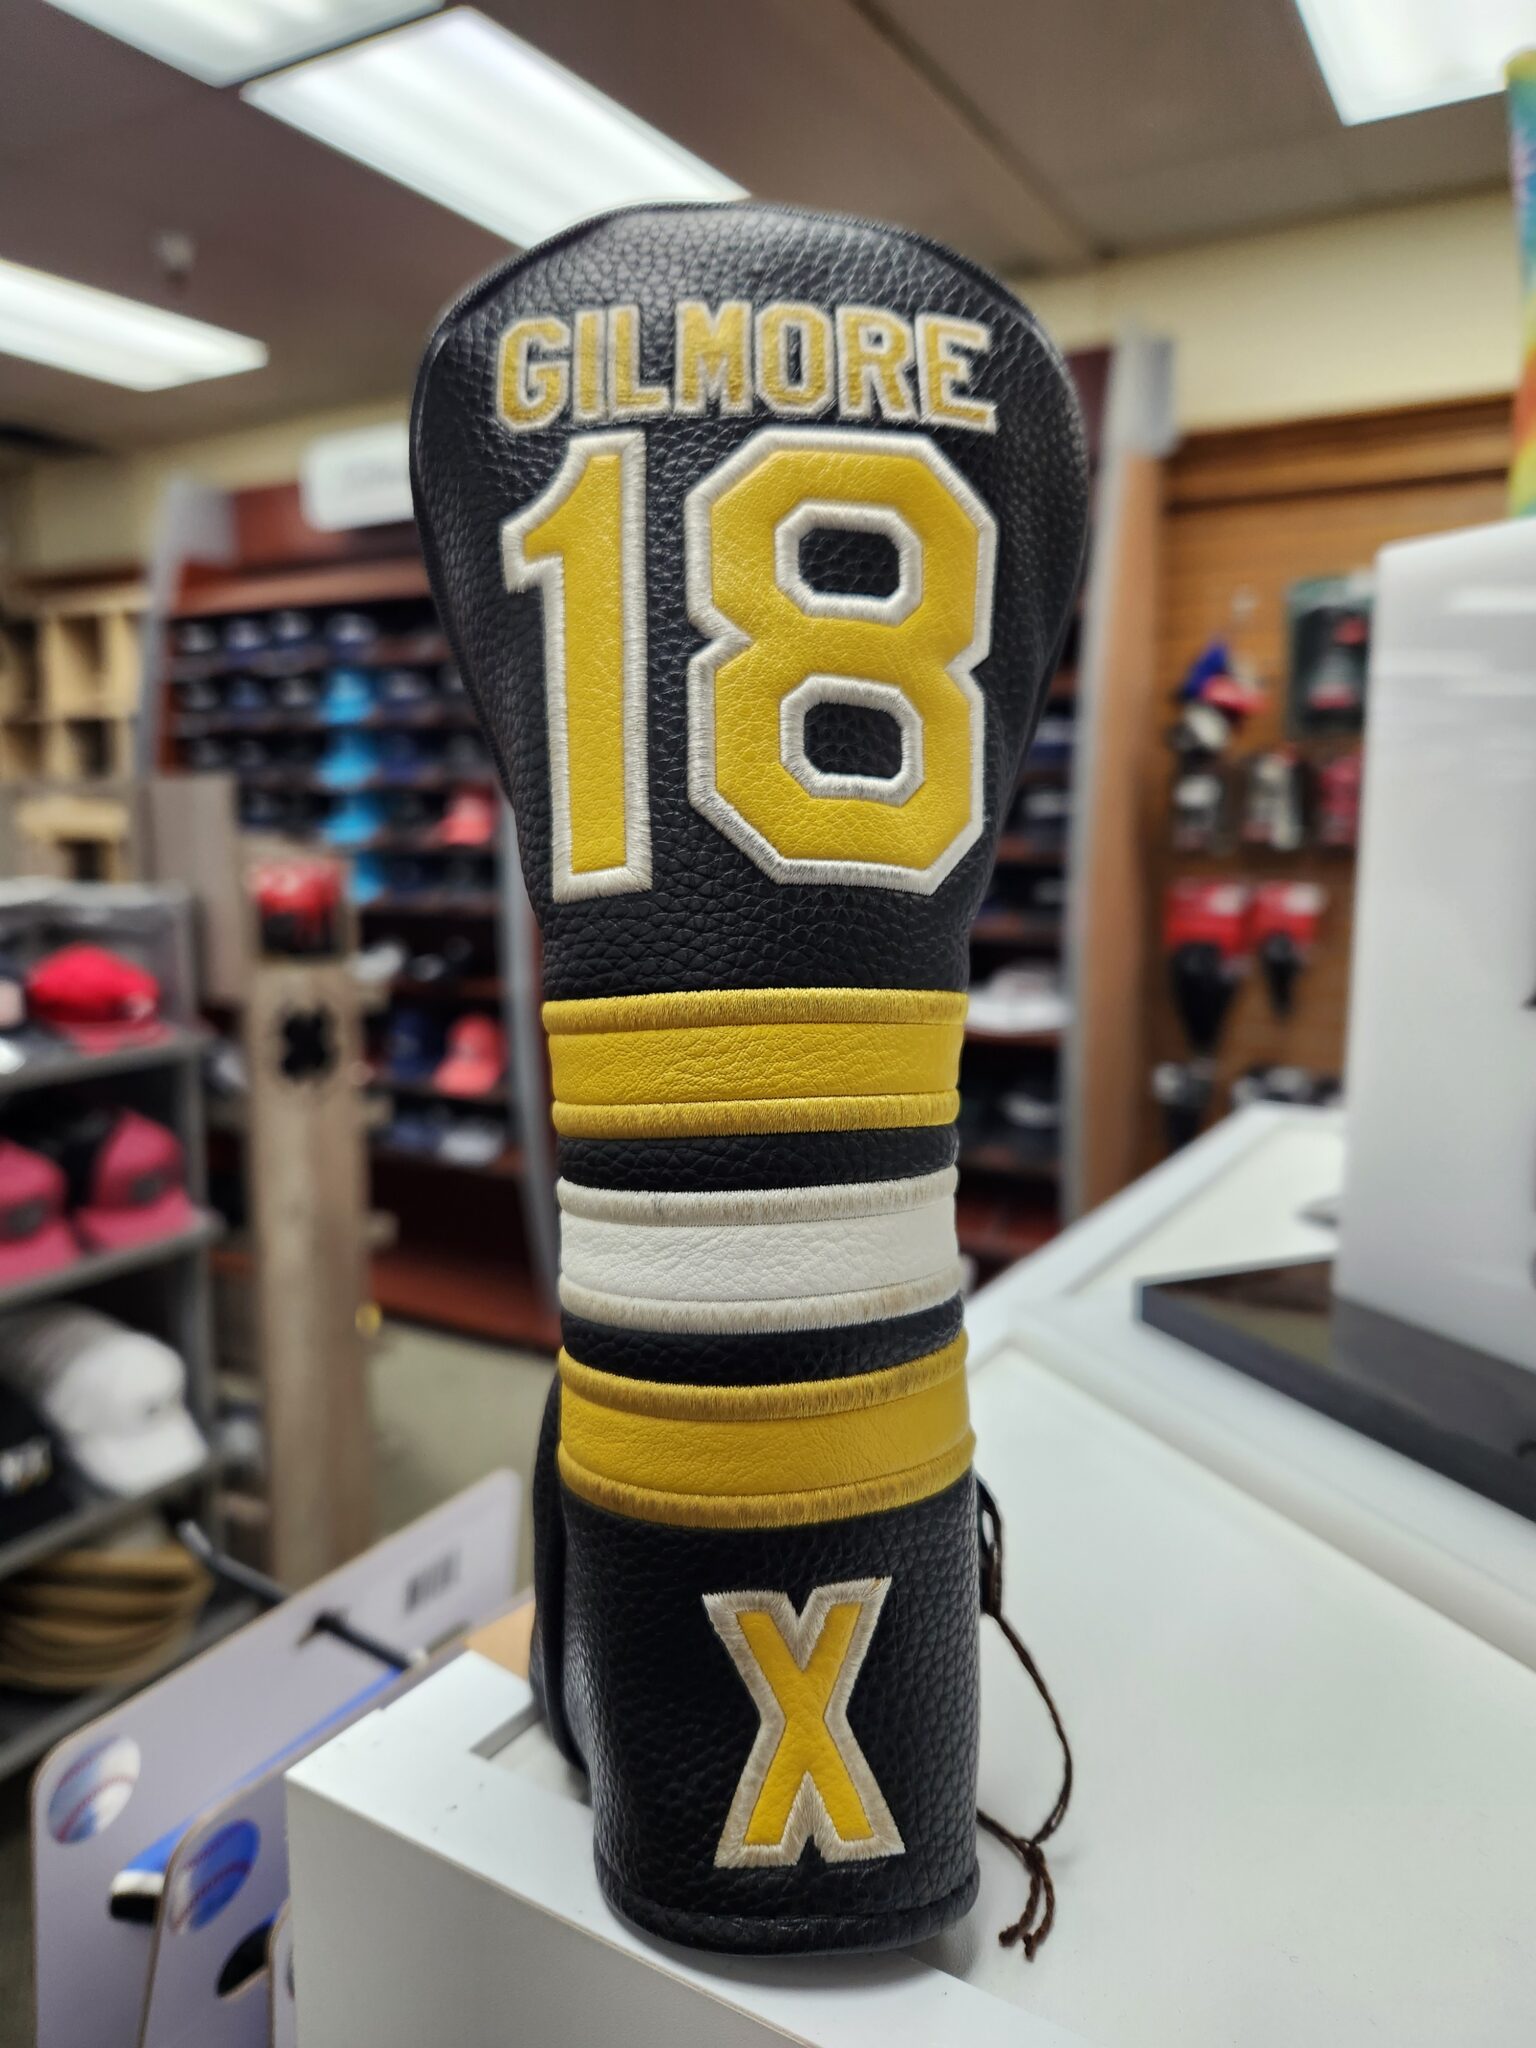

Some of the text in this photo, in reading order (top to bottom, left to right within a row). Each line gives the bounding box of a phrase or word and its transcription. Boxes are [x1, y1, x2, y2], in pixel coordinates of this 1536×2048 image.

[495, 301, 998, 431] GILMORE
[500, 427, 999, 904] 18
[702, 1576, 906, 1869] X
